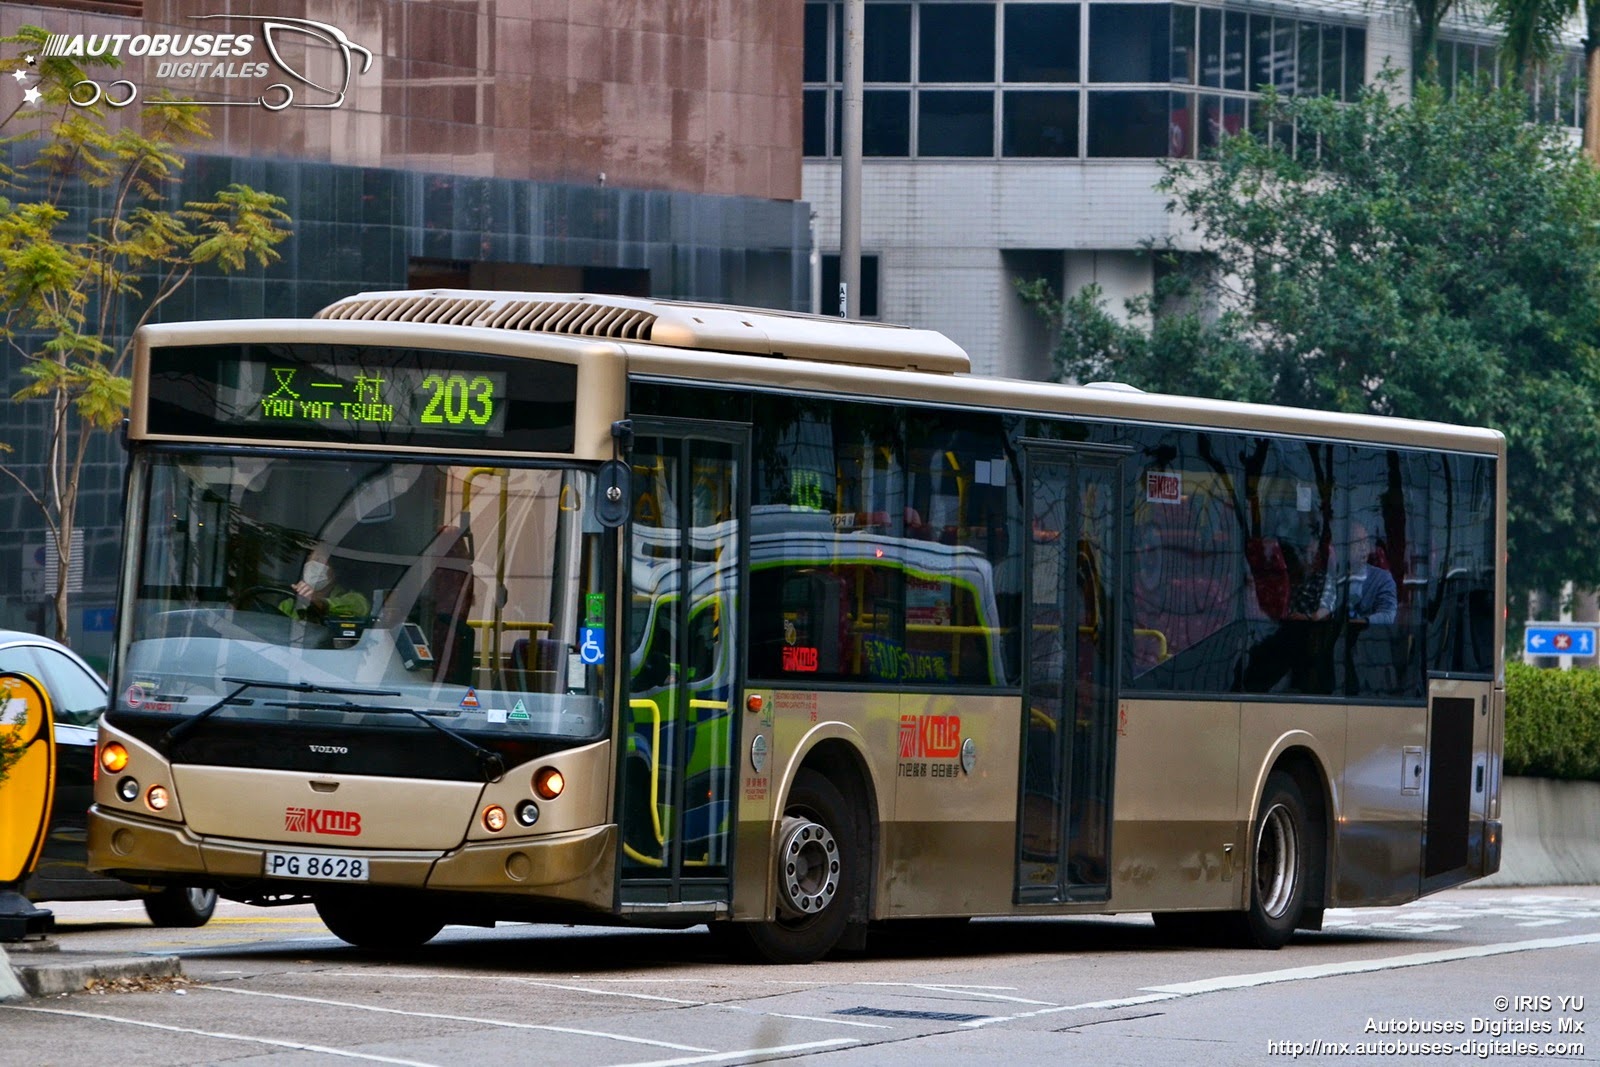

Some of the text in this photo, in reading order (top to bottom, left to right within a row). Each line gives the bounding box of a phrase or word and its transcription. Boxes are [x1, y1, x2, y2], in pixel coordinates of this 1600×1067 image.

[267, 367, 386, 403] 又一村
[262, 399, 393, 422] YAU YAT TSUEN
[421, 374, 495, 425] 203
[309, 744, 348, 755] VOLVO
[918, 715, 961, 758] KMB
[305, 808, 361, 836] KMB
[273, 854, 362, 879] PG 8628
